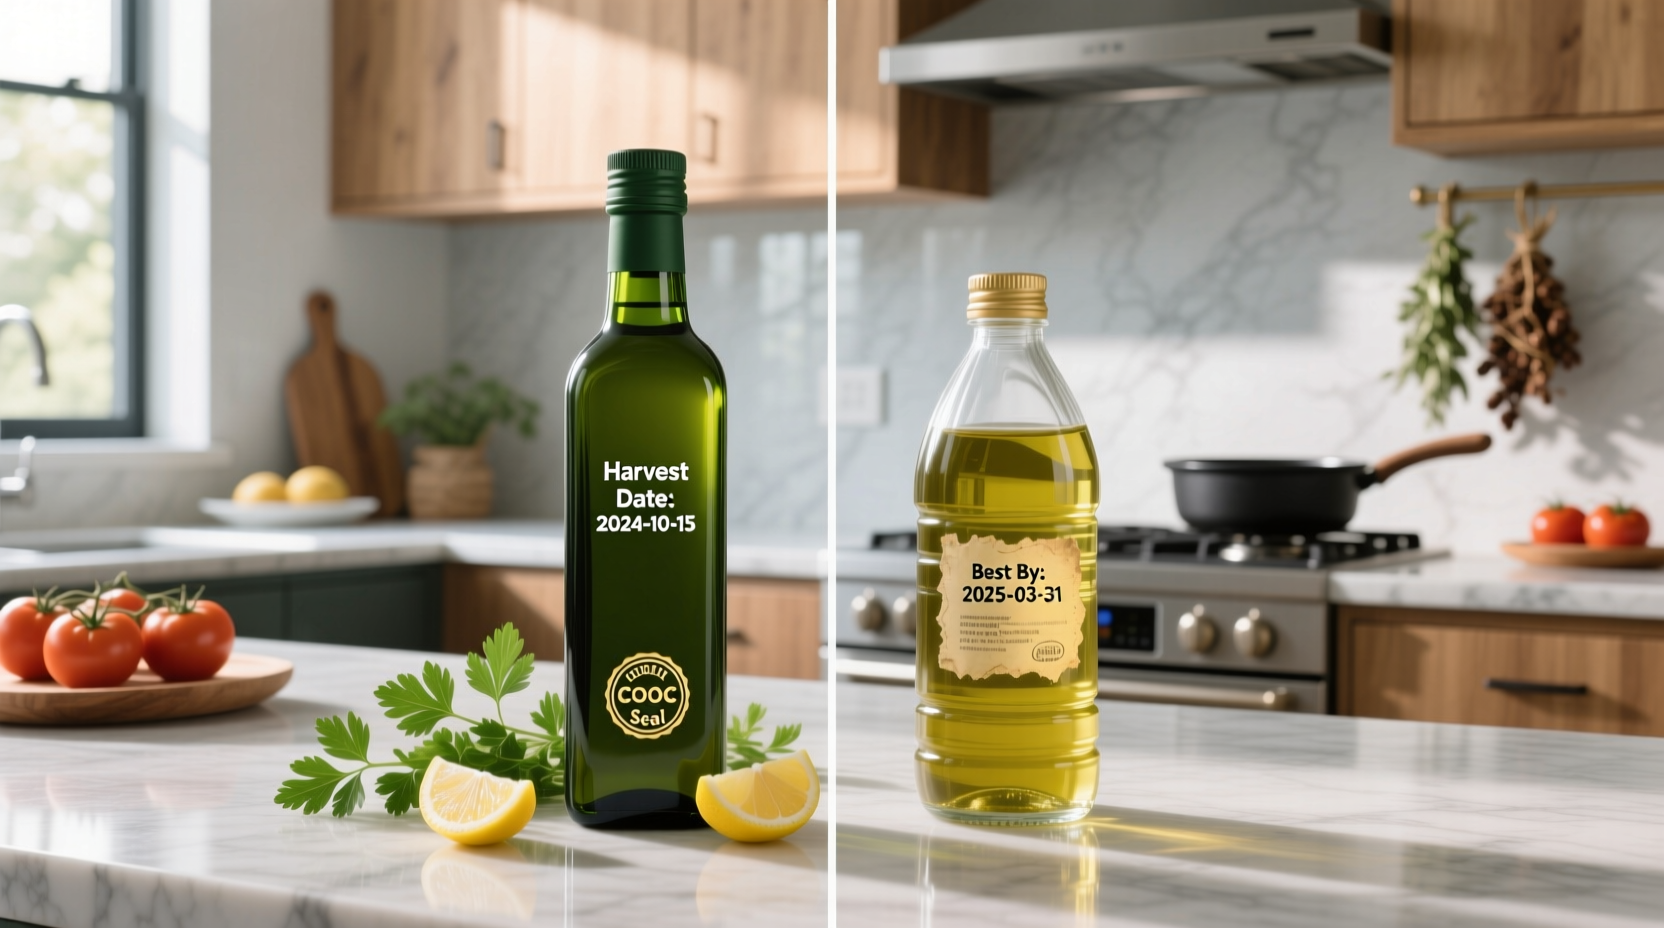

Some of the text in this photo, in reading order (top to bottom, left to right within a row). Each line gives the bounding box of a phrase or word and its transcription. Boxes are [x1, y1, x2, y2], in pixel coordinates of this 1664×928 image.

[604, 461, 689, 481] Harvest
[616, 488, 675, 508] Date:
[596, 515, 696, 532] 2024-10-15
[972, 563, 1045, 585] Best By:
[962, 586, 1062, 603] 2025-03-31
[617, 686, 677, 704] COOC
[630, 709, 666, 726] Seal
